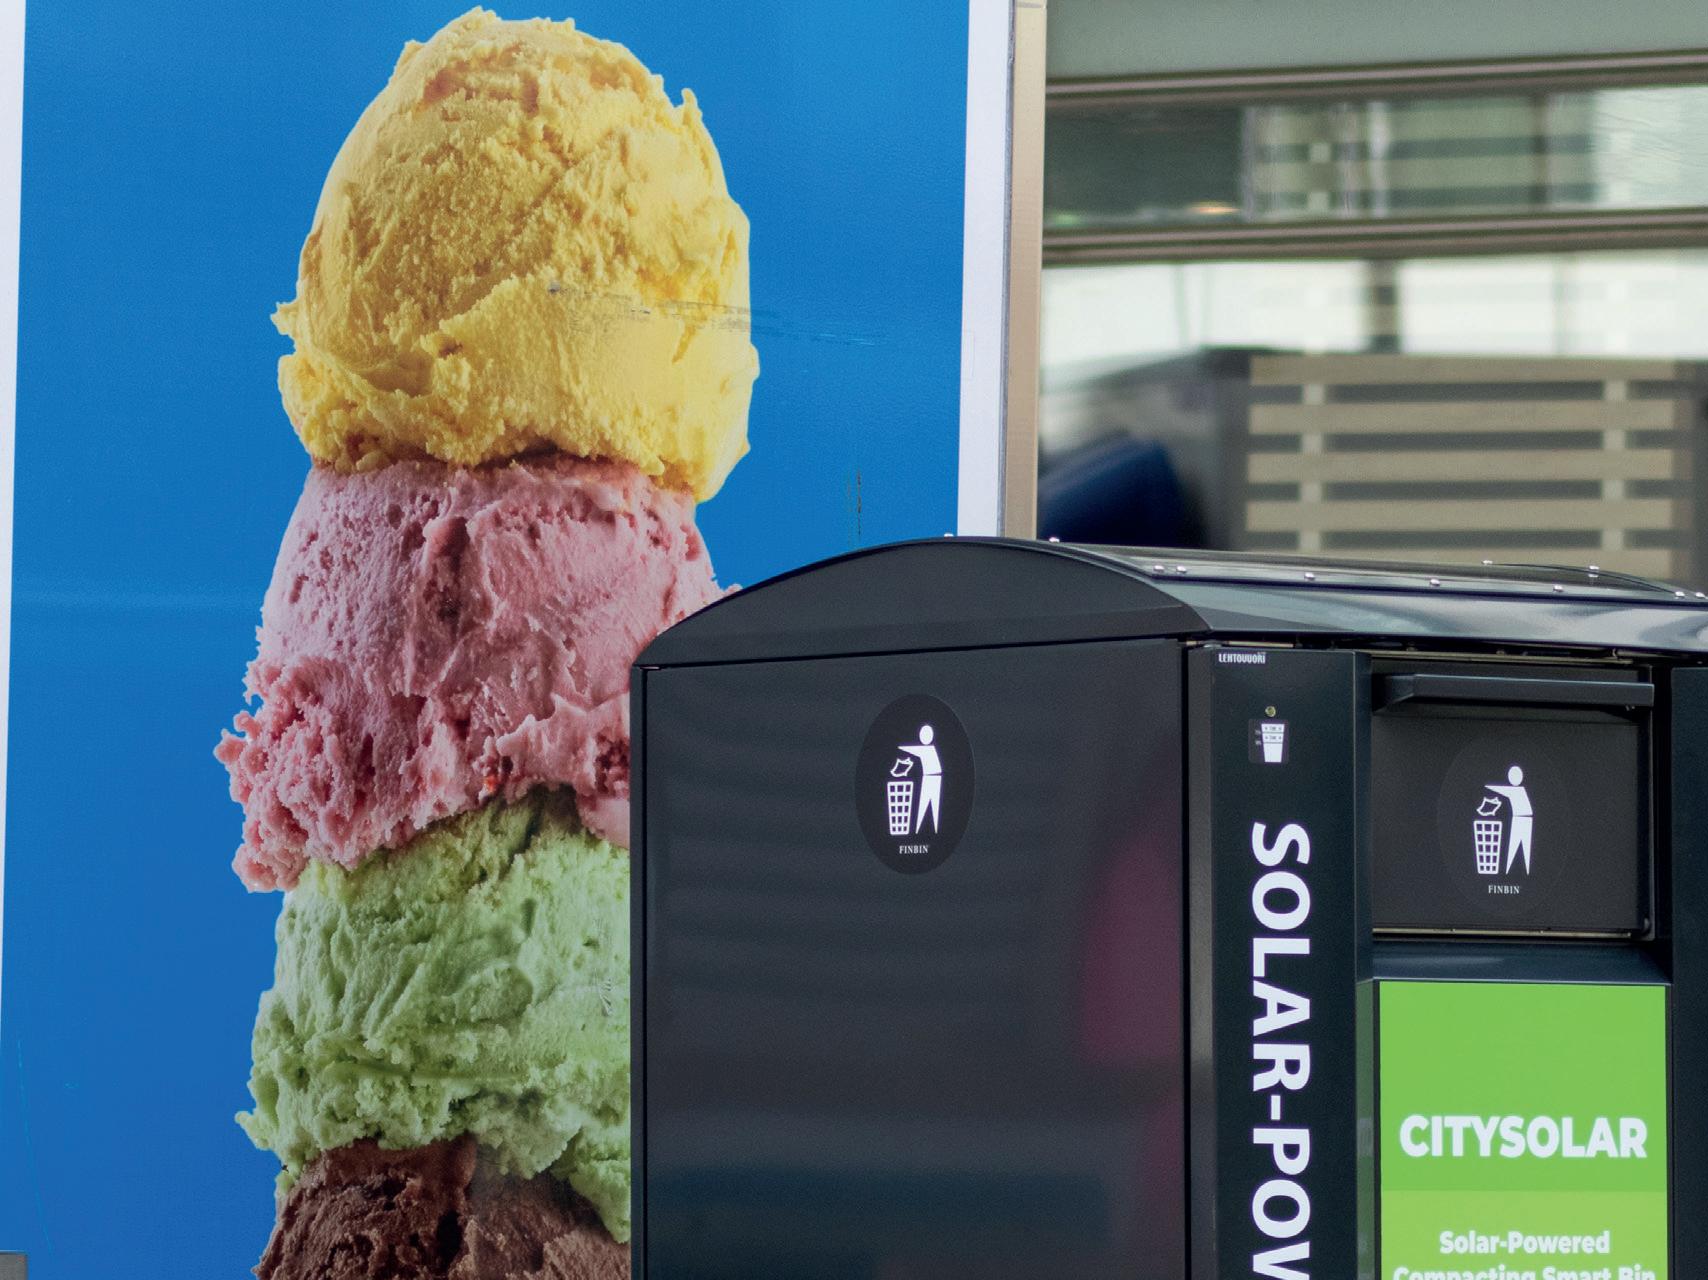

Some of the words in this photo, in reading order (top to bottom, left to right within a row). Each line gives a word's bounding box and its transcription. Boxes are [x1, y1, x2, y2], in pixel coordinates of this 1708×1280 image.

[899, 844, 929, 855] FINBIN
[1488, 884, 1520, 895] FINBIN
[1399, 1114, 1648, 1158] CITYSOLAR
[1439, 1230, 1611, 1254] Solar-Powered
